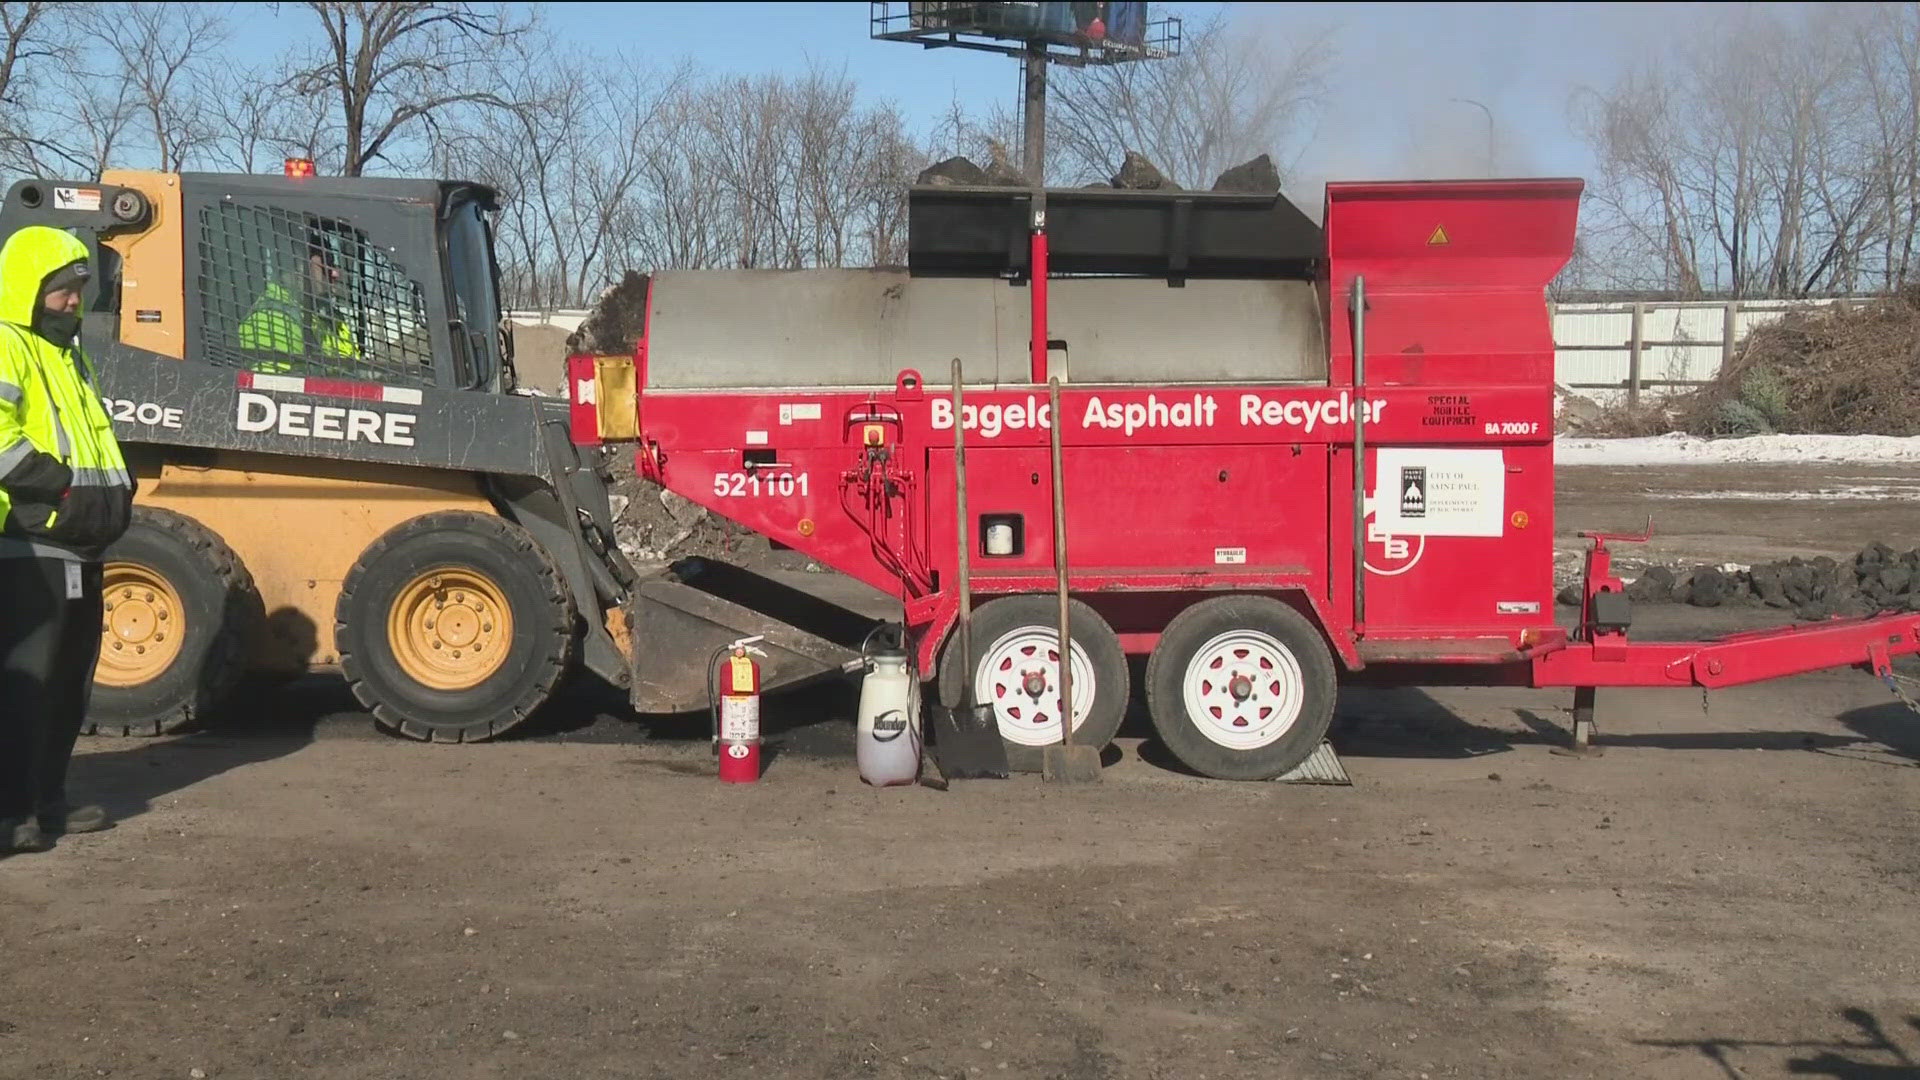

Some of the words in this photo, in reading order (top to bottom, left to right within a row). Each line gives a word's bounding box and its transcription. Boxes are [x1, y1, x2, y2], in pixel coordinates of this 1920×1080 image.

[1427, 396, 1470, 405] SPECIAL
[1082, 393, 1218, 437] Asphalt
[1240, 391, 1387, 433] Recycler
[1433, 406, 1470, 415] MOBILE
[237, 392, 416, 446] DEERE
[1422, 416, 1476, 426] EQUIPMENT
[1485, 423, 1500, 435] BA
[1502, 422, 1530, 435] 7000
[1532, 423, 1539, 434] F
[713, 472, 808, 497] 521101
